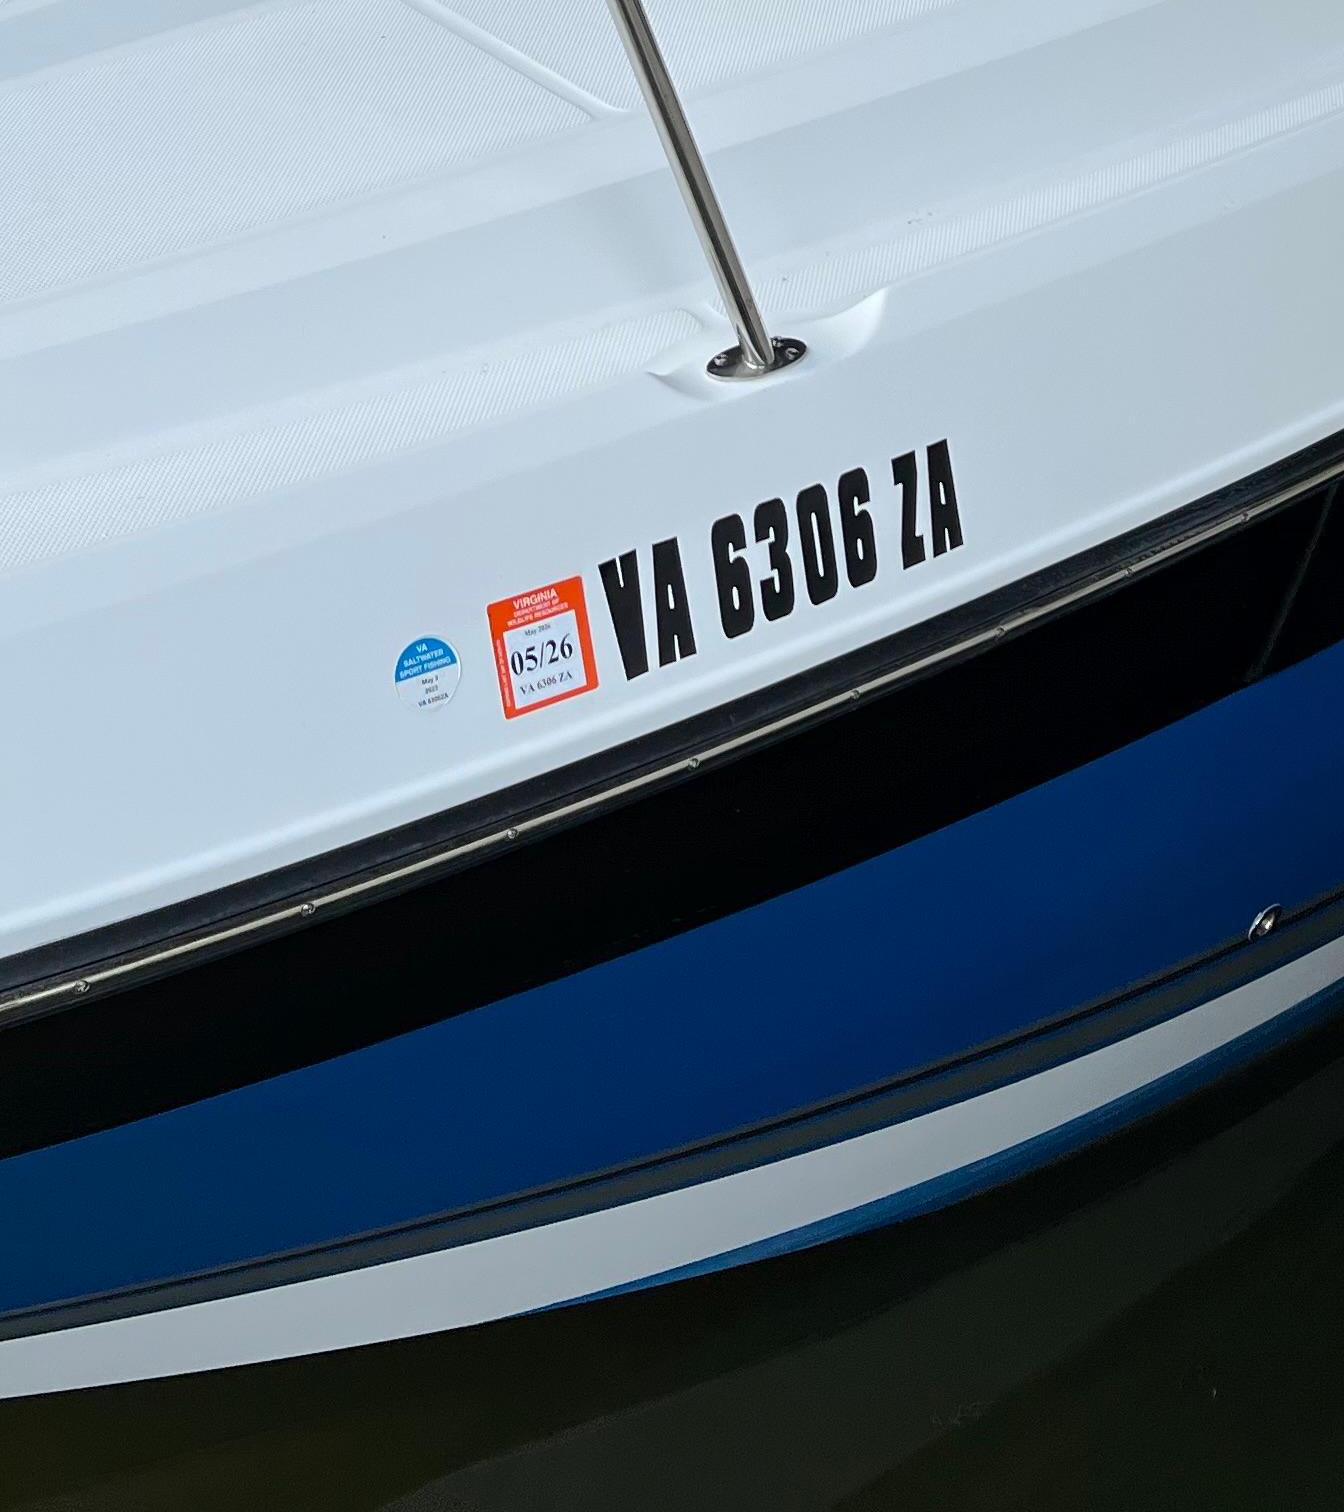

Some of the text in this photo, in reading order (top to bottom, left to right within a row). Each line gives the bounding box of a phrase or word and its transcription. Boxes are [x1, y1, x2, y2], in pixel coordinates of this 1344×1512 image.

[598, 536, 697, 681] VA
[711, 466, 878, 639] 6306
[891, 438, 964, 570] ZA
[513, 587, 558, 609] VIRGINIA
[403, 648, 444, 668] SALTWATER
[416, 642, 428, 653] VA
[510, 632, 573, 676] 05/26
[399, 664, 423, 679] SPORT
[519, 670, 573, 695] VA 6306 ZA
